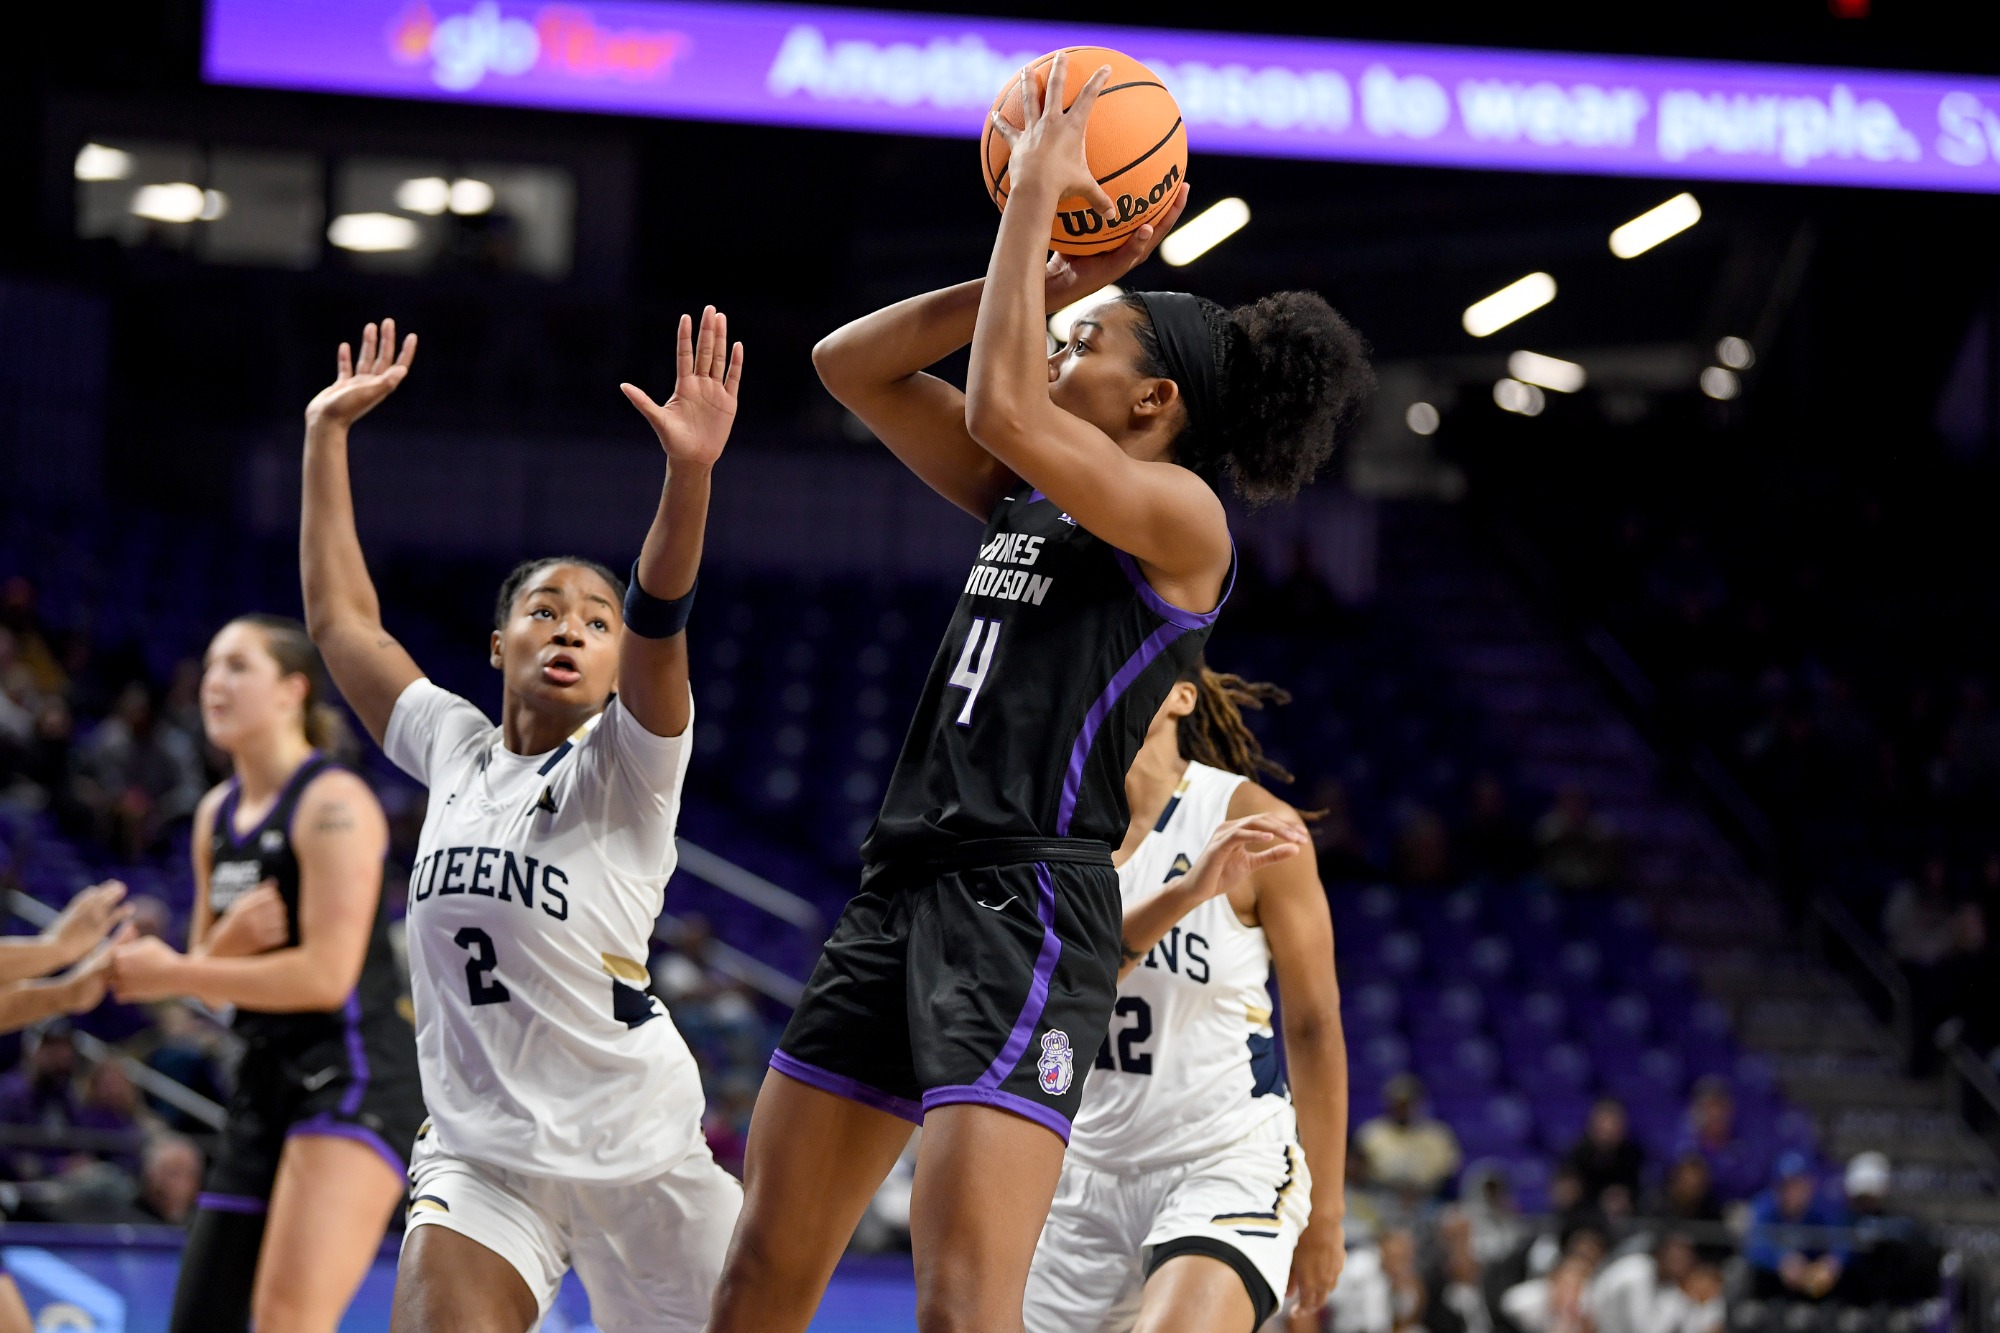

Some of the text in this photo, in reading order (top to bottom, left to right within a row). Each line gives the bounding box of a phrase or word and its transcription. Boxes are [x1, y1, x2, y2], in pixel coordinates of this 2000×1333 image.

[1361, 63, 1450, 138] to
[1457, 78, 1648, 148] wear
[980, 532, 1046, 566] AMES
[948, 617, 1002, 727] 4
[454, 927, 511, 1006] 2
